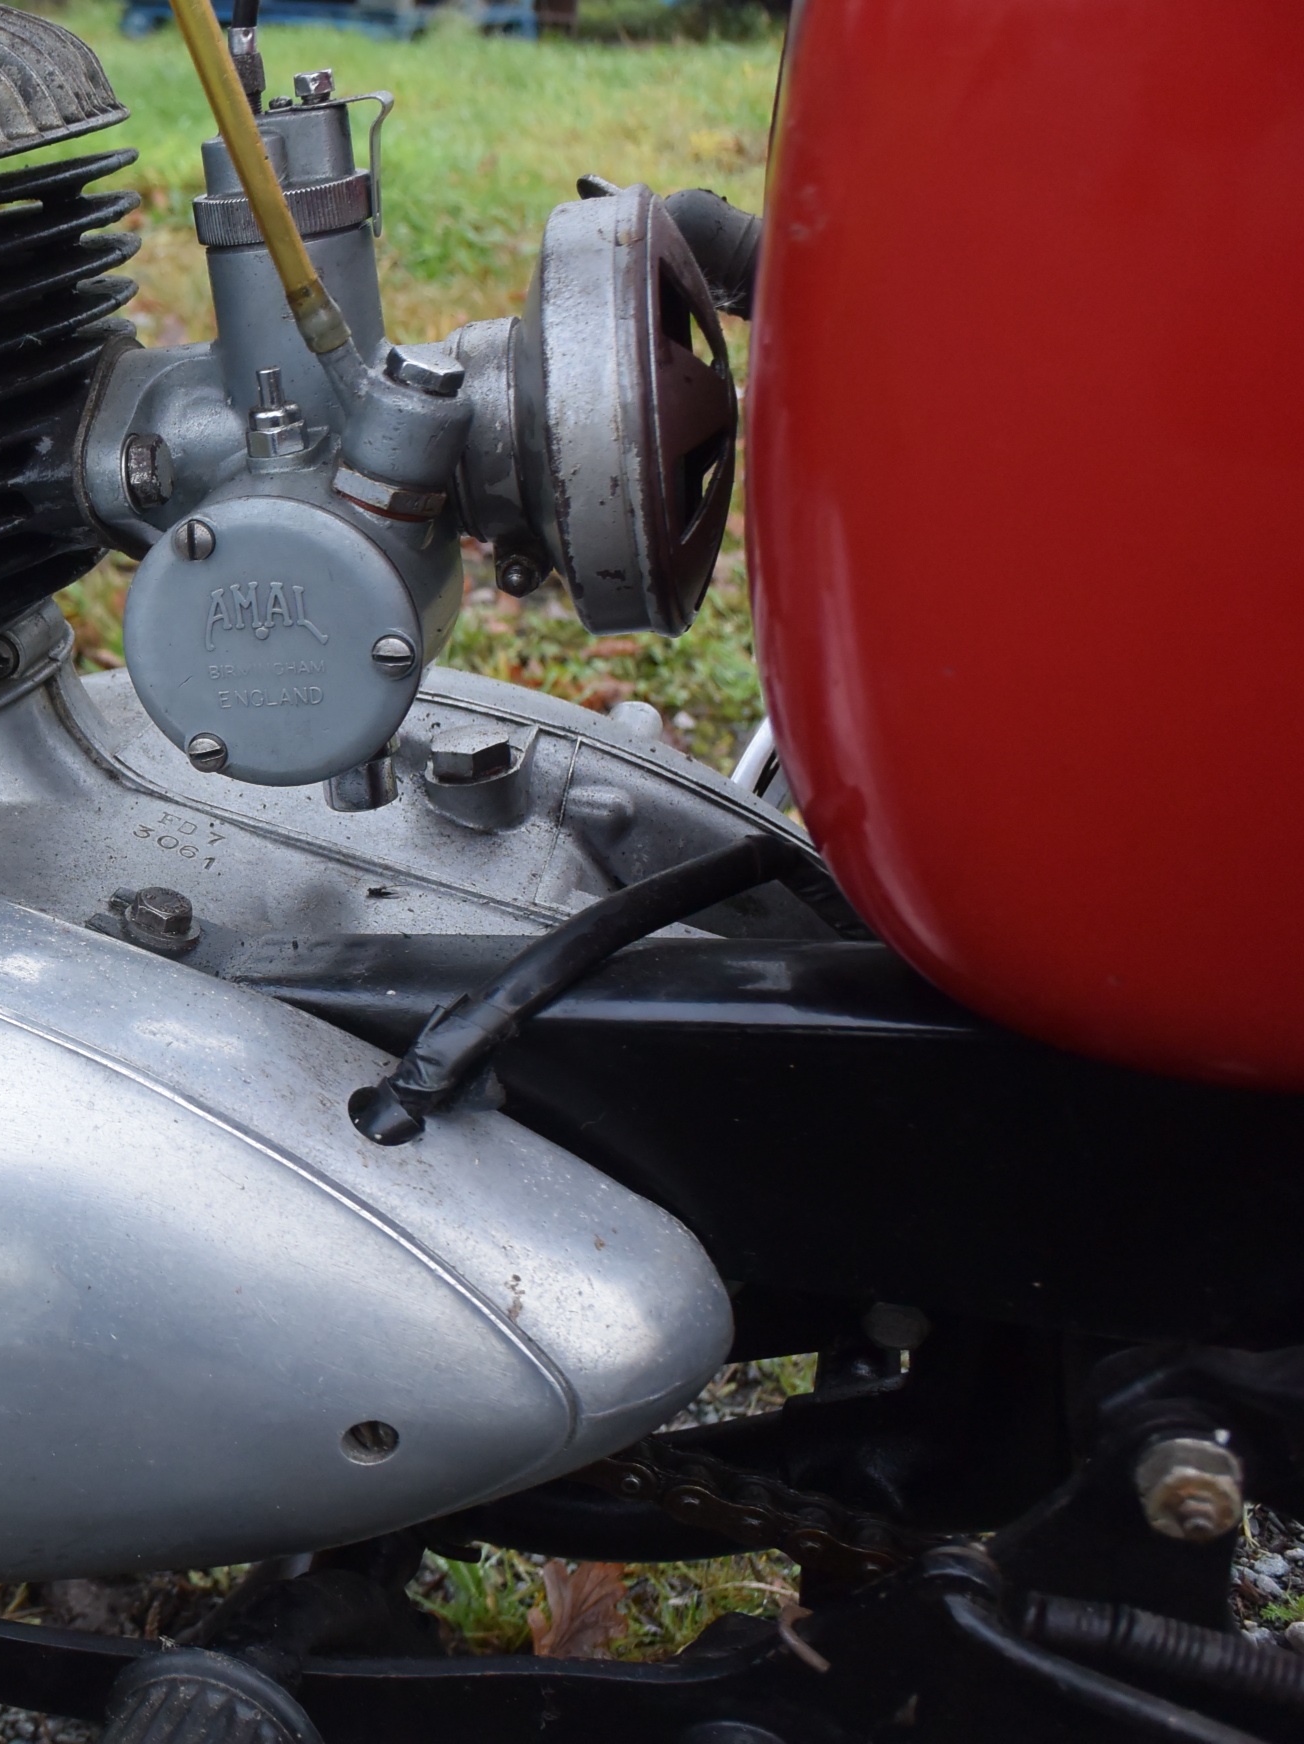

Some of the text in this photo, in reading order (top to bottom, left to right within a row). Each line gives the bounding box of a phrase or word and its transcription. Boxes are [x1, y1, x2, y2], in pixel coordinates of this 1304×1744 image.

[205, 581, 329, 651] AMAL
[208, 660, 326, 680] BIRMGHAM
[218, 686, 324, 709] ENGLAND
[132, 824, 217, 870] 3061
